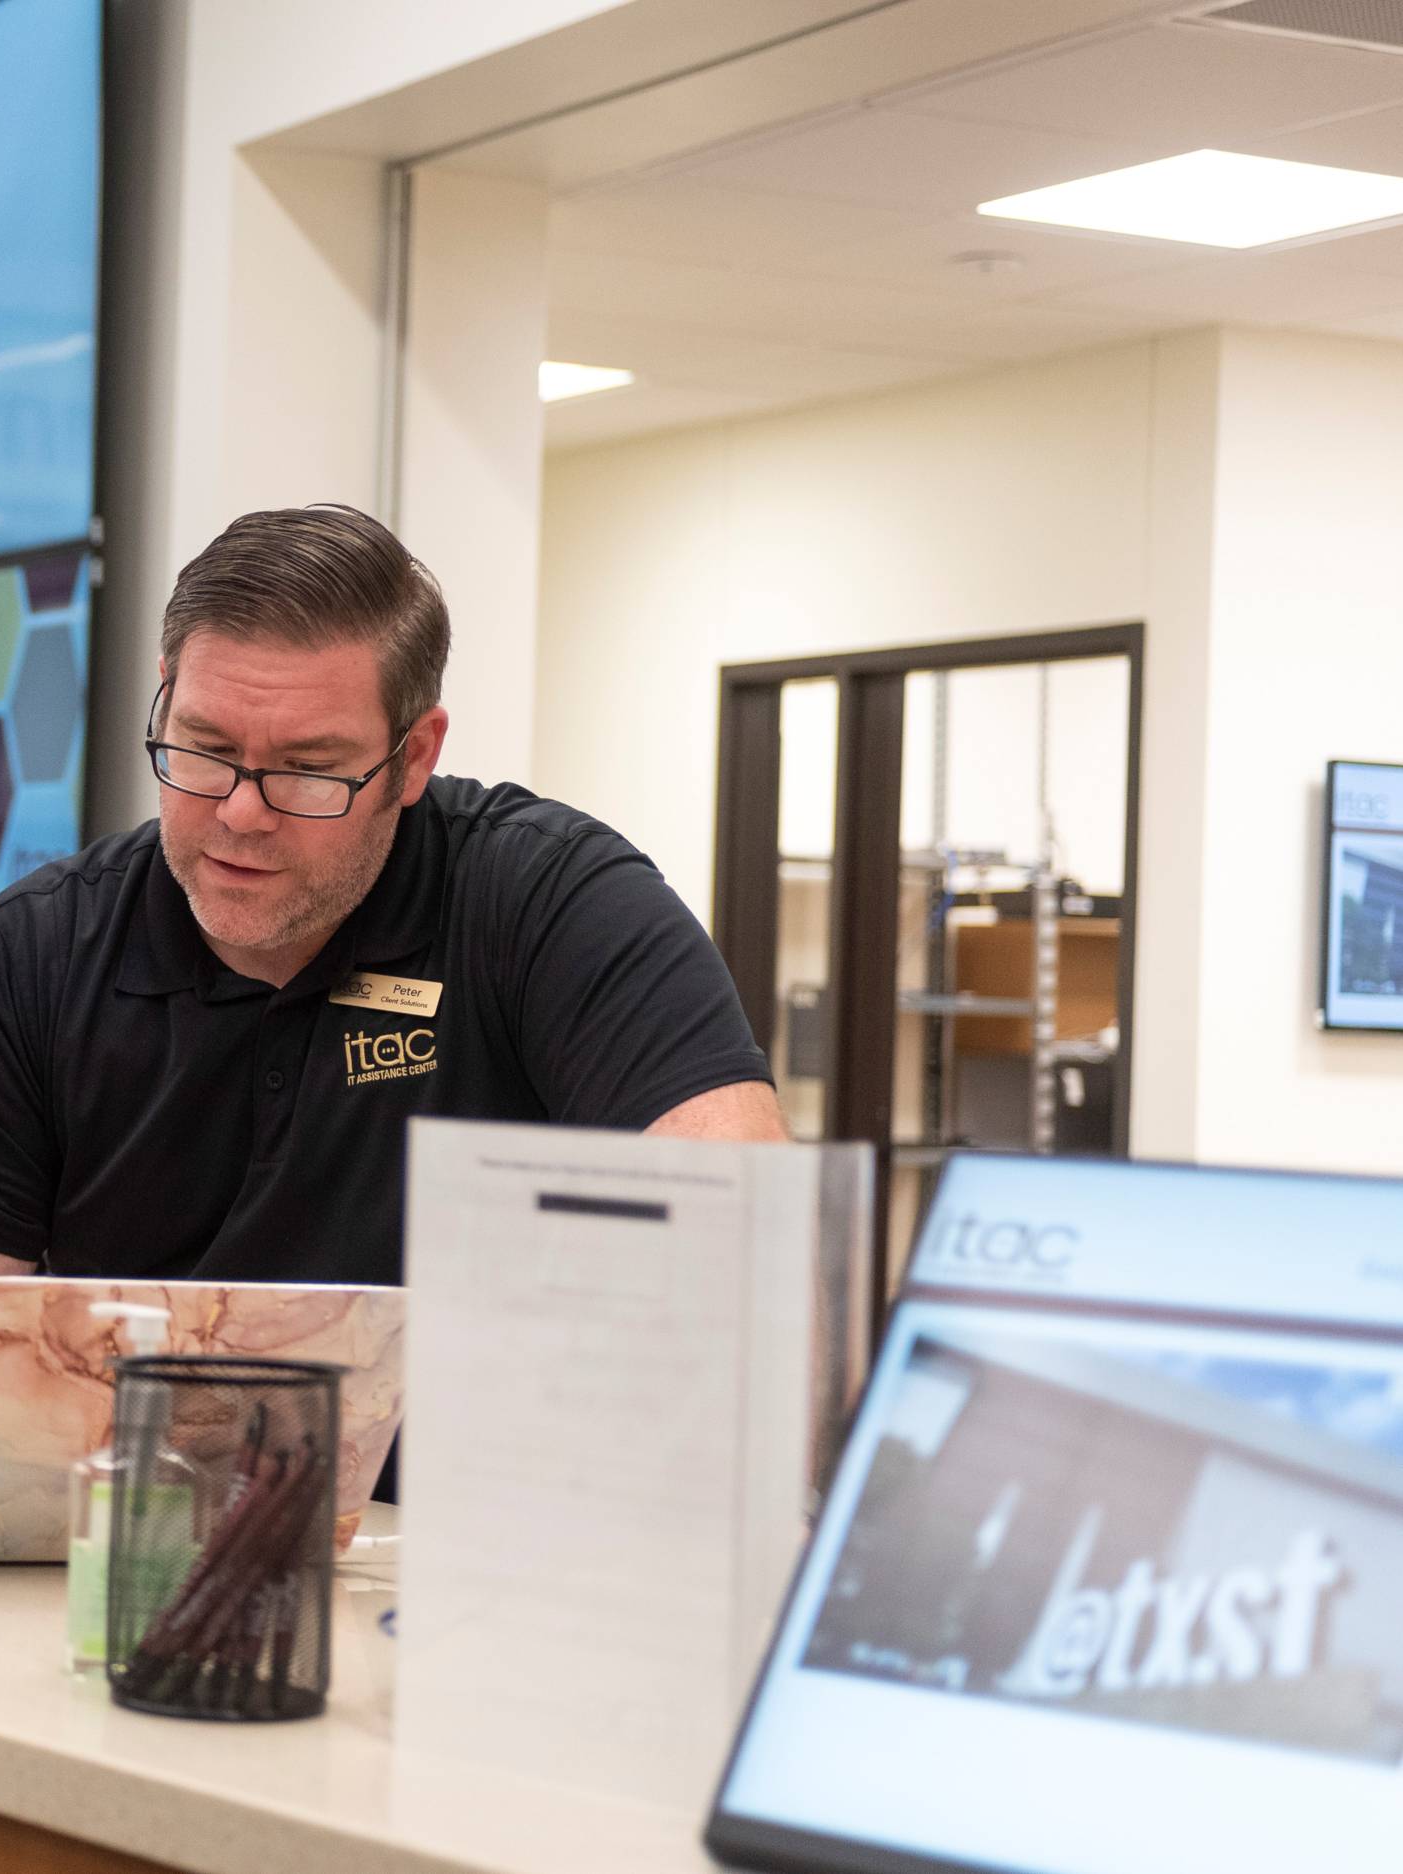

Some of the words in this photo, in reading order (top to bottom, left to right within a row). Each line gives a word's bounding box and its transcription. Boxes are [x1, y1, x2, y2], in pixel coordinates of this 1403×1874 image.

[342, 980, 373, 995] ac
[393, 984, 423, 997] Peter
[380, 996, 398, 1005] Client
[399, 998, 428, 1009] Solutions
[344, 1028, 436, 1073] itac
[347, 1075, 356, 1087] IT
[356, 1066, 408, 1084] ASSISTANCE
[408, 1059, 438, 1076] CENTER
[929, 1206, 1081, 1268] itac
